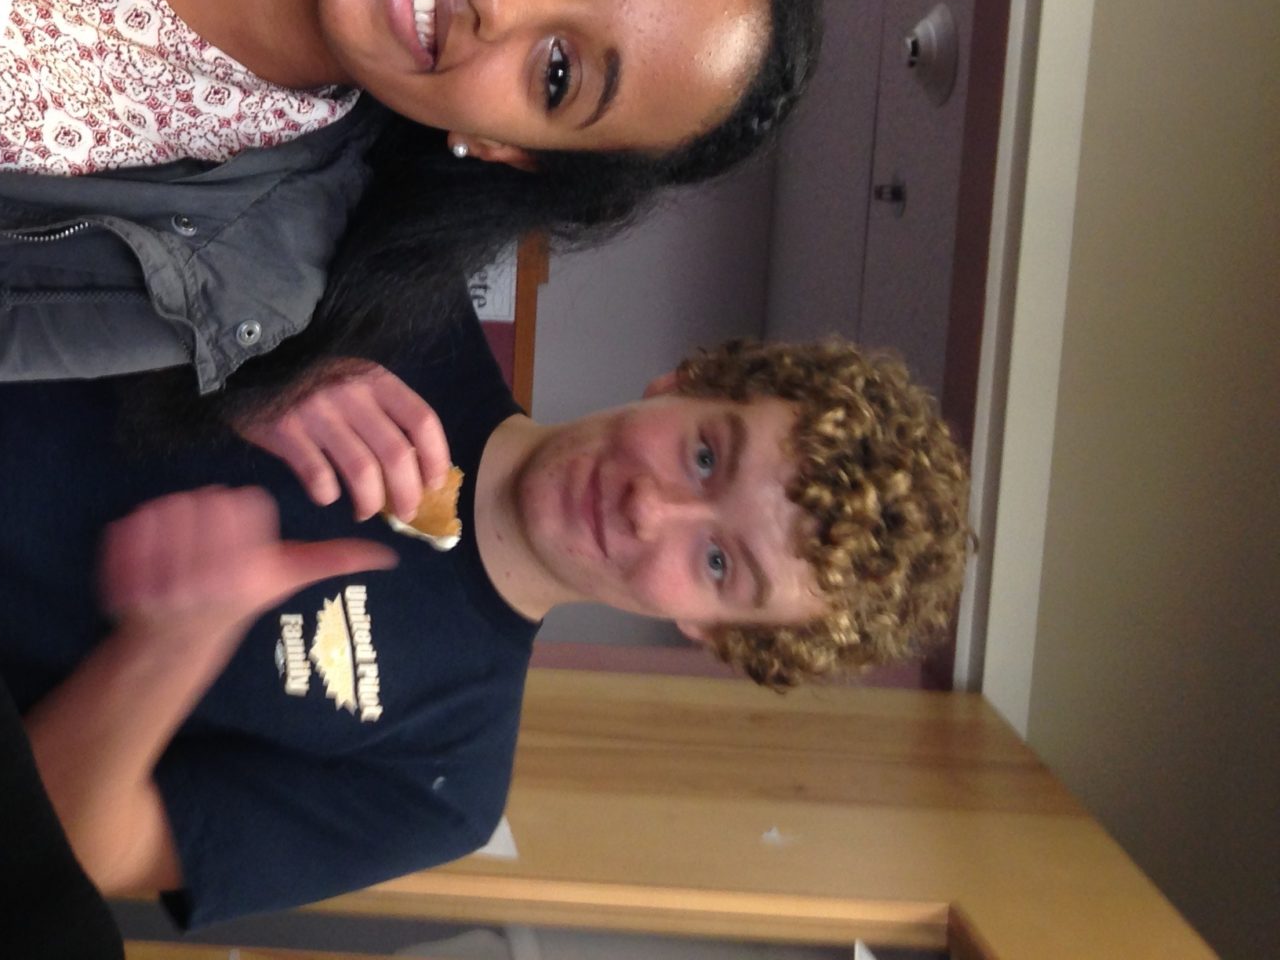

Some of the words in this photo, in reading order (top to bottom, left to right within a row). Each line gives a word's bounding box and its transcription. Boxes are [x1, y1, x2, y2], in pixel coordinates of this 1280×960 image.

[280, 613, 312, 697] Family
[345, 584, 377, 663] United
[357, 664, 384, 722] Pilot
